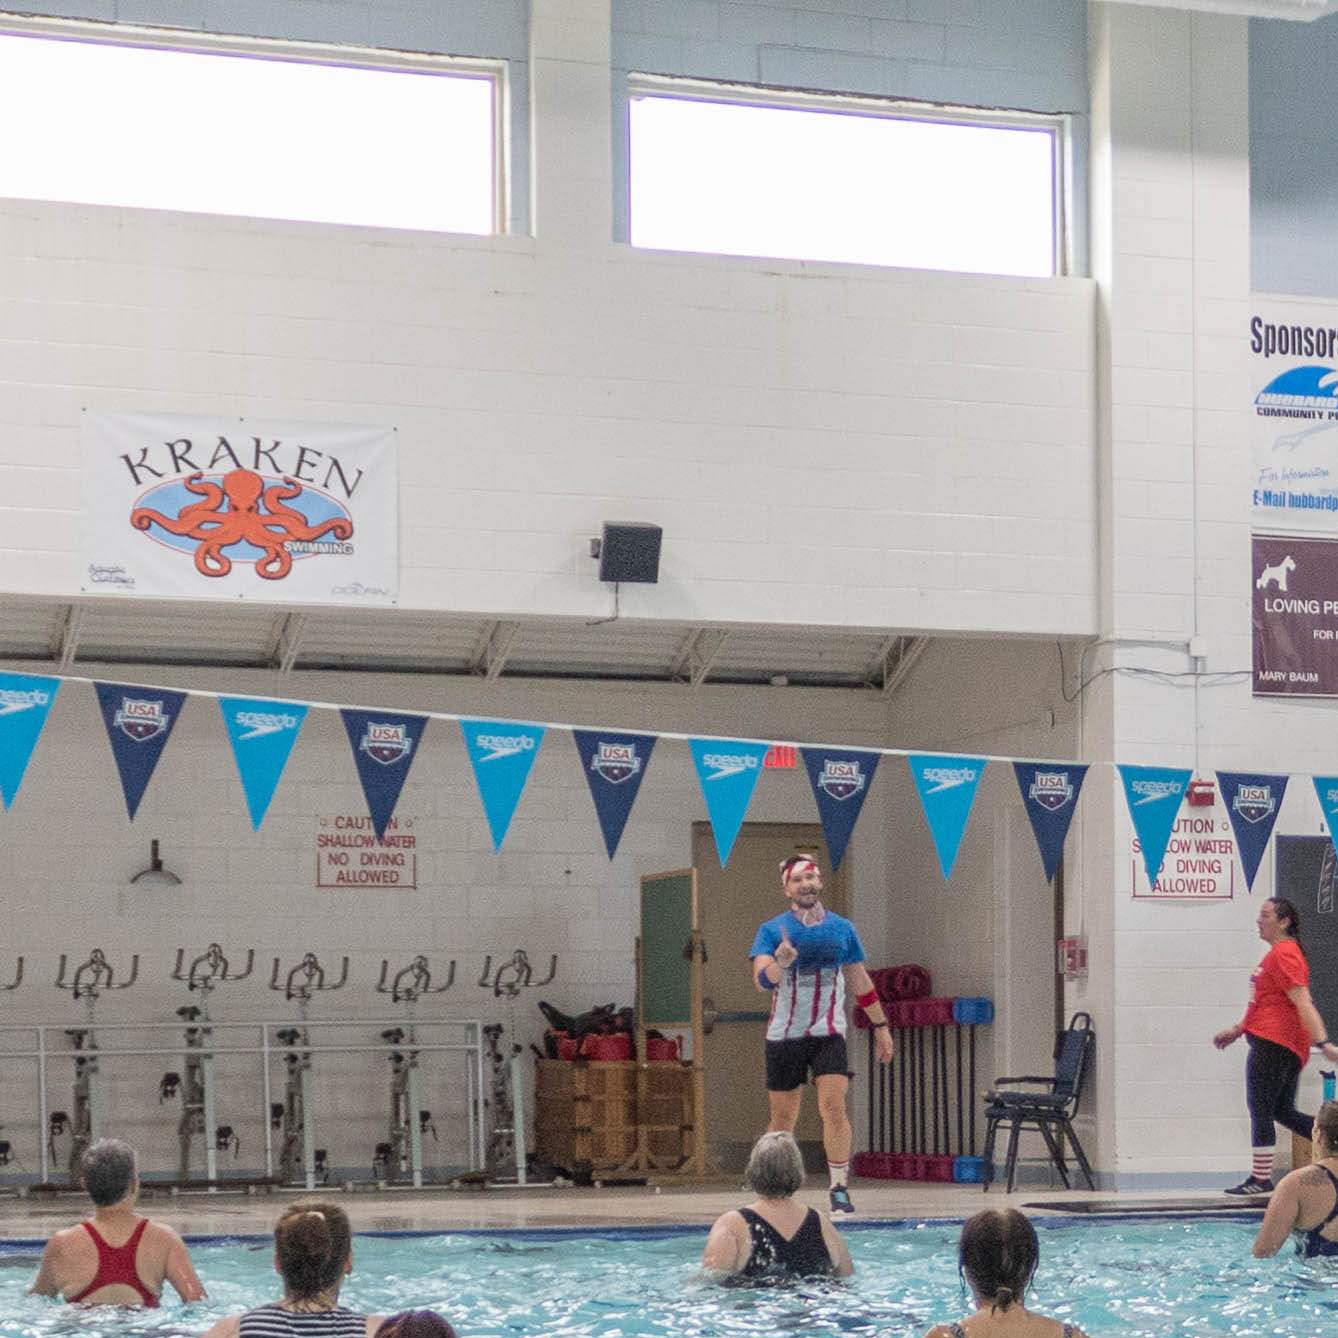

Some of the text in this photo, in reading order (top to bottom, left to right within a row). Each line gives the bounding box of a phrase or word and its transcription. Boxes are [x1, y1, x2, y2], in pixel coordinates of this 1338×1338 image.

[1257, 407, 1323, 420] COMMUNITY
[120, 436, 363, 498] KRAKEN
[1253, 489, 1287, 508] E-Mail
[283, 540, 354, 555] SWIMMING
[1264, 598, 1320, 615] LOVING
[1313, 630, 1334, 640] FOR
[1259, 671, 1319, 683] MARY BAUM
[0, 690, 48, 705] peedo
[127, 703, 156, 717] USA
[235, 711, 297, 729] speedo
[372, 728, 400, 740] USA
[476, 734, 535, 750] speedo
[603, 747, 630, 759] USA
[703, 752, 757, 768] speedo
[828, 766, 855, 777] USA
[923, 767, 976, 783] speedo
[1039, 776, 1063, 788] USA
[1131, 780, 1182, 794] speedo
[1242, 789, 1266, 801] USA
[335, 816, 398, 829] CAUTN
[317, 835, 374, 848] SHALLOW
[1195, 840, 1233, 854] WATER
[328, 852, 405, 866] NO DIVING
[1177, 859, 1221, 873] DIVING
[336, 870, 399, 883] ALLOWED
[1152, 879, 1217, 893] ALLOWED
